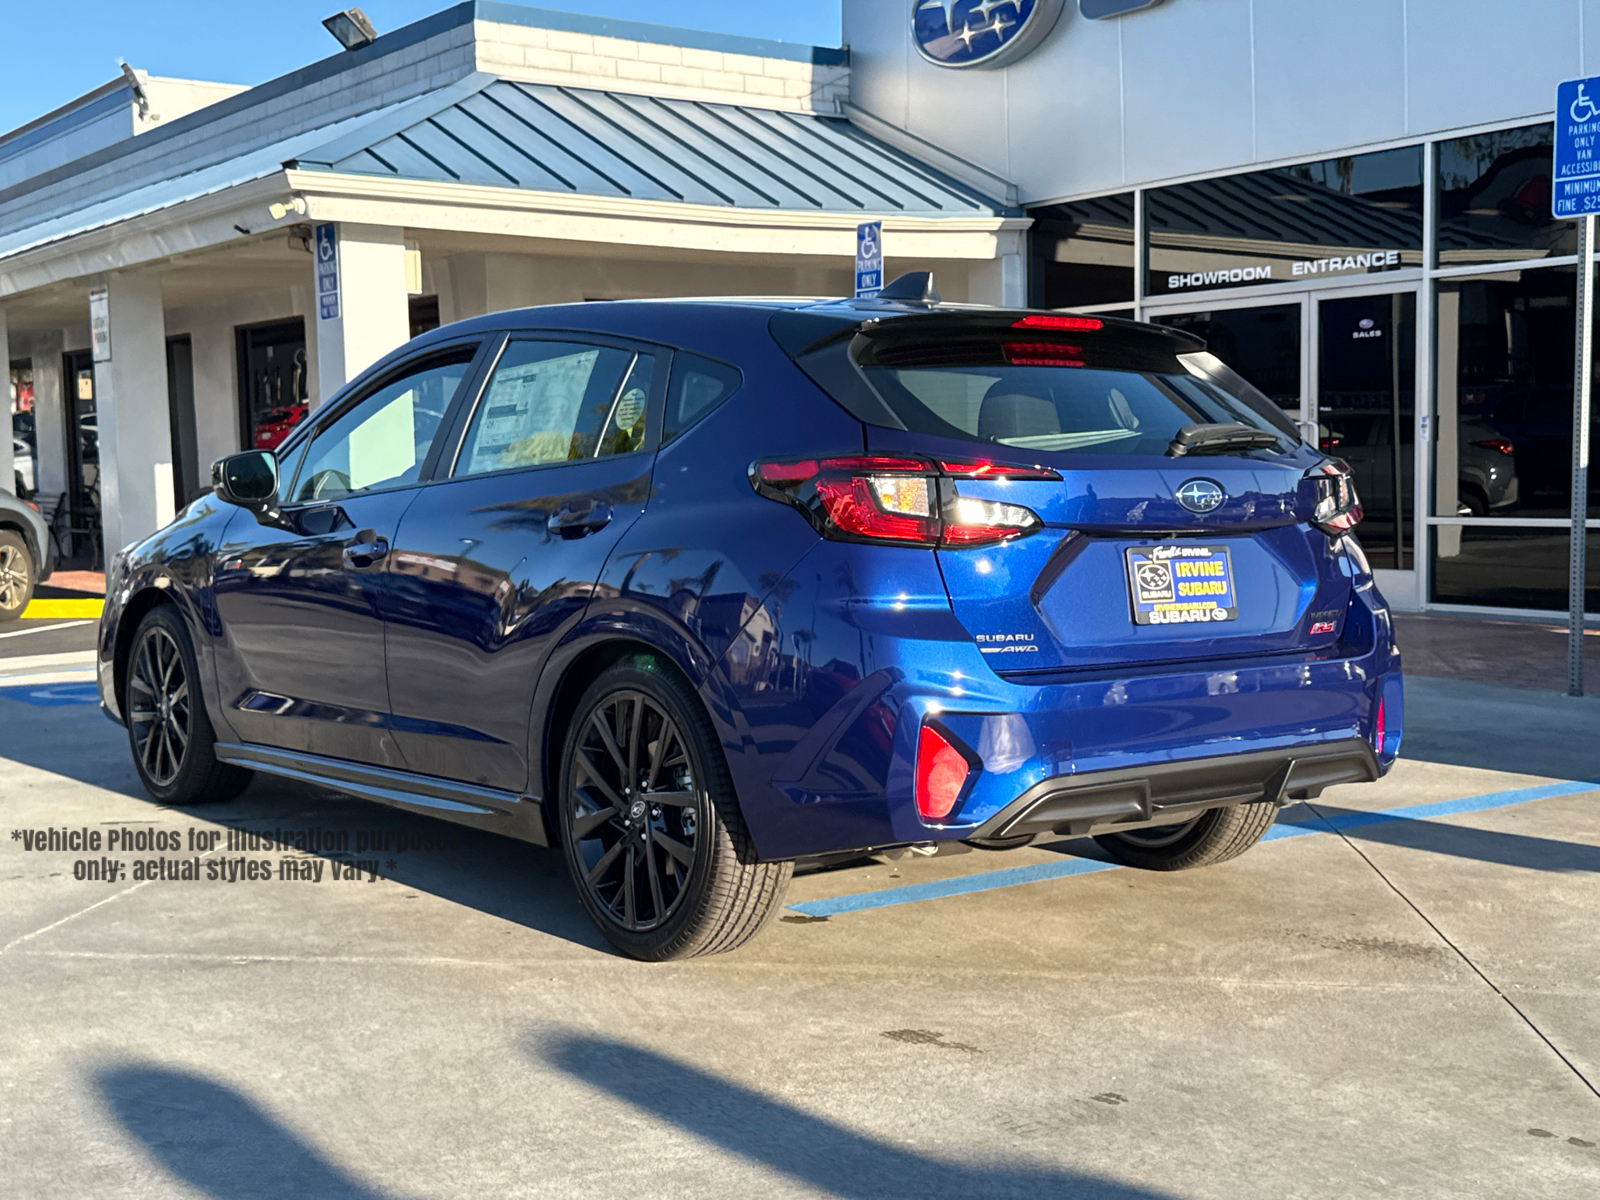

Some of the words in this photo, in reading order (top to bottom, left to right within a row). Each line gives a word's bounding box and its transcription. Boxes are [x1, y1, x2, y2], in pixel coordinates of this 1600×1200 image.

[1574, 136, 1595, 148] ONLY
[1576, 149, 1592, 161] VAN
[1557, 198, 1577, 212] FINE
[1168, 266, 1271, 288] SHOWROOM
[1292, 250, 1399, 275] ENTRANCE
[1352, 329, 1382, 339] SALES
[1175, 561, 1224, 577] IRVINE
[1142, 590, 1171, 599] SUBARU
[1177, 581, 1227, 596] SUBARU
[1149, 609, 1211, 624] SUBARU
[975, 633, 1034, 642] SUBARU
[1000, 645, 1039, 653] AWD
